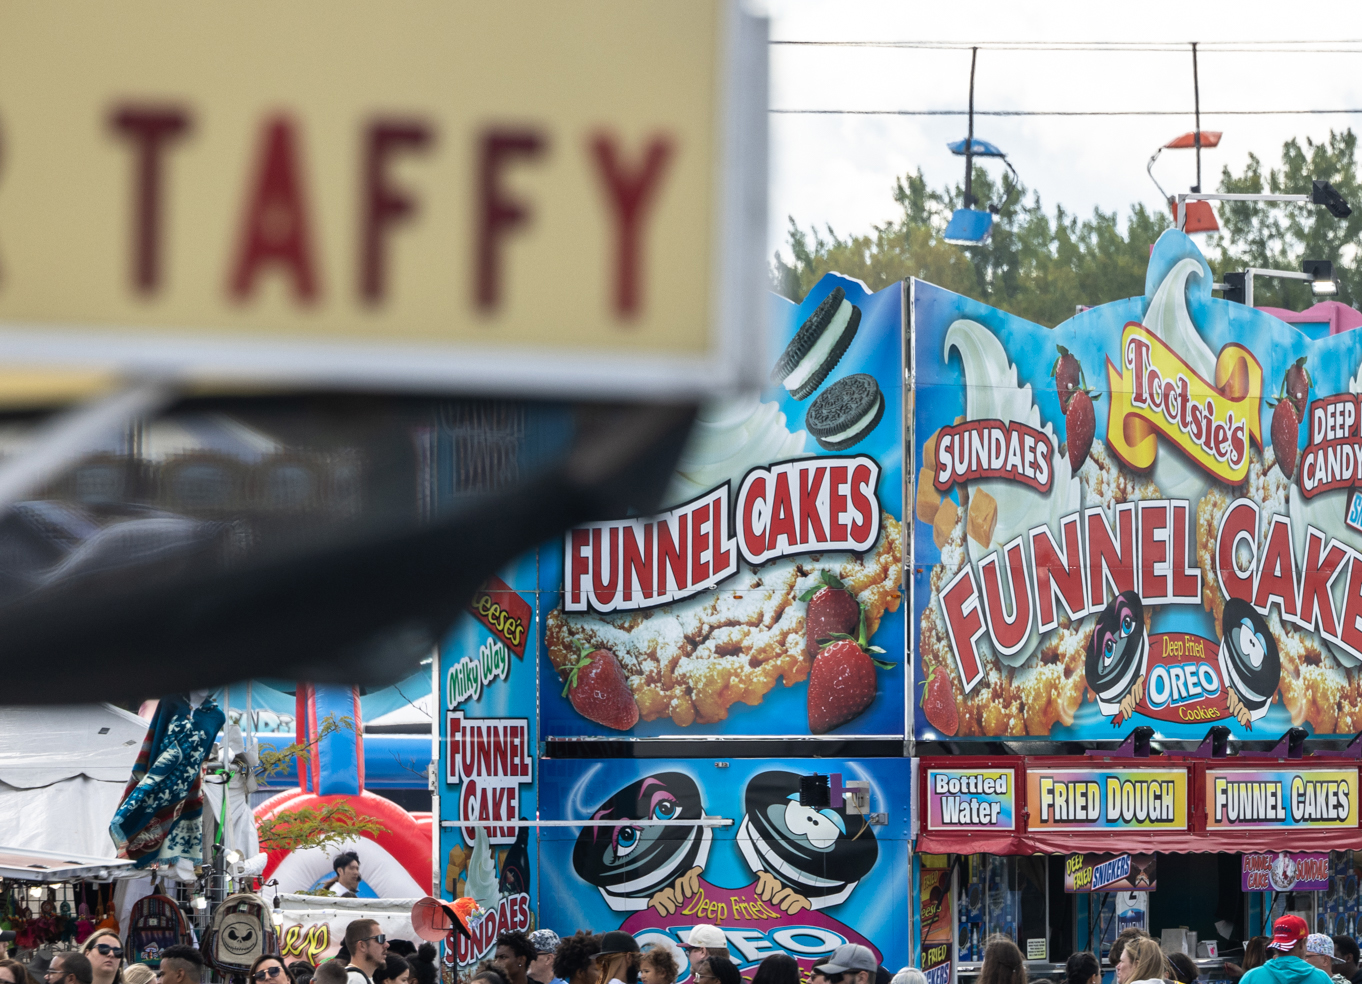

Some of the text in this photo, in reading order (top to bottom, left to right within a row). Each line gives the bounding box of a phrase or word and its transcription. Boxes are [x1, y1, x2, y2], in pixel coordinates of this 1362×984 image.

[106, 102, 680, 322] TAFFY
[1126, 336, 1247, 464] Tootsie's
[1313, 402, 1355, 446] DEEP
[938, 428, 1050, 489] SUNDAES
[567, 459, 878, 611] FUNNEL CAKES
[941, 499, 1200, 693] FUNNEL
[471, 590, 524, 646] eese's
[1162, 636, 1205, 660] Deep Fried
[448, 641, 509, 705] Milky Way
[1148, 663, 1219, 706] OREO
[1179, 706, 1220, 721] Cookies
[448, 714, 531, 780] FUNNEL
[935, 773, 1007, 795] Bottled
[1040, 777, 1175, 823] FRIED DOUGH
[1214, 776, 1350, 823] FUNNEL CAKES
[463, 782, 517, 843] CAKE
[941, 800, 1001, 825] Water
[923, 870, 939, 891] FRIED
[1066, 854, 1084, 877] DEEP
[1073, 866, 1093, 891] FRIED
[1092, 854, 1131, 890] SNICKERS
[1243, 854, 1329, 882] FUNNEL SUNDAE
[1247, 871, 1269, 889] CAKE
[681, 888, 781, 924] Deep Fried
[444, 893, 532, 966] SUNDAES
[928, 944, 947, 966] FRIED
